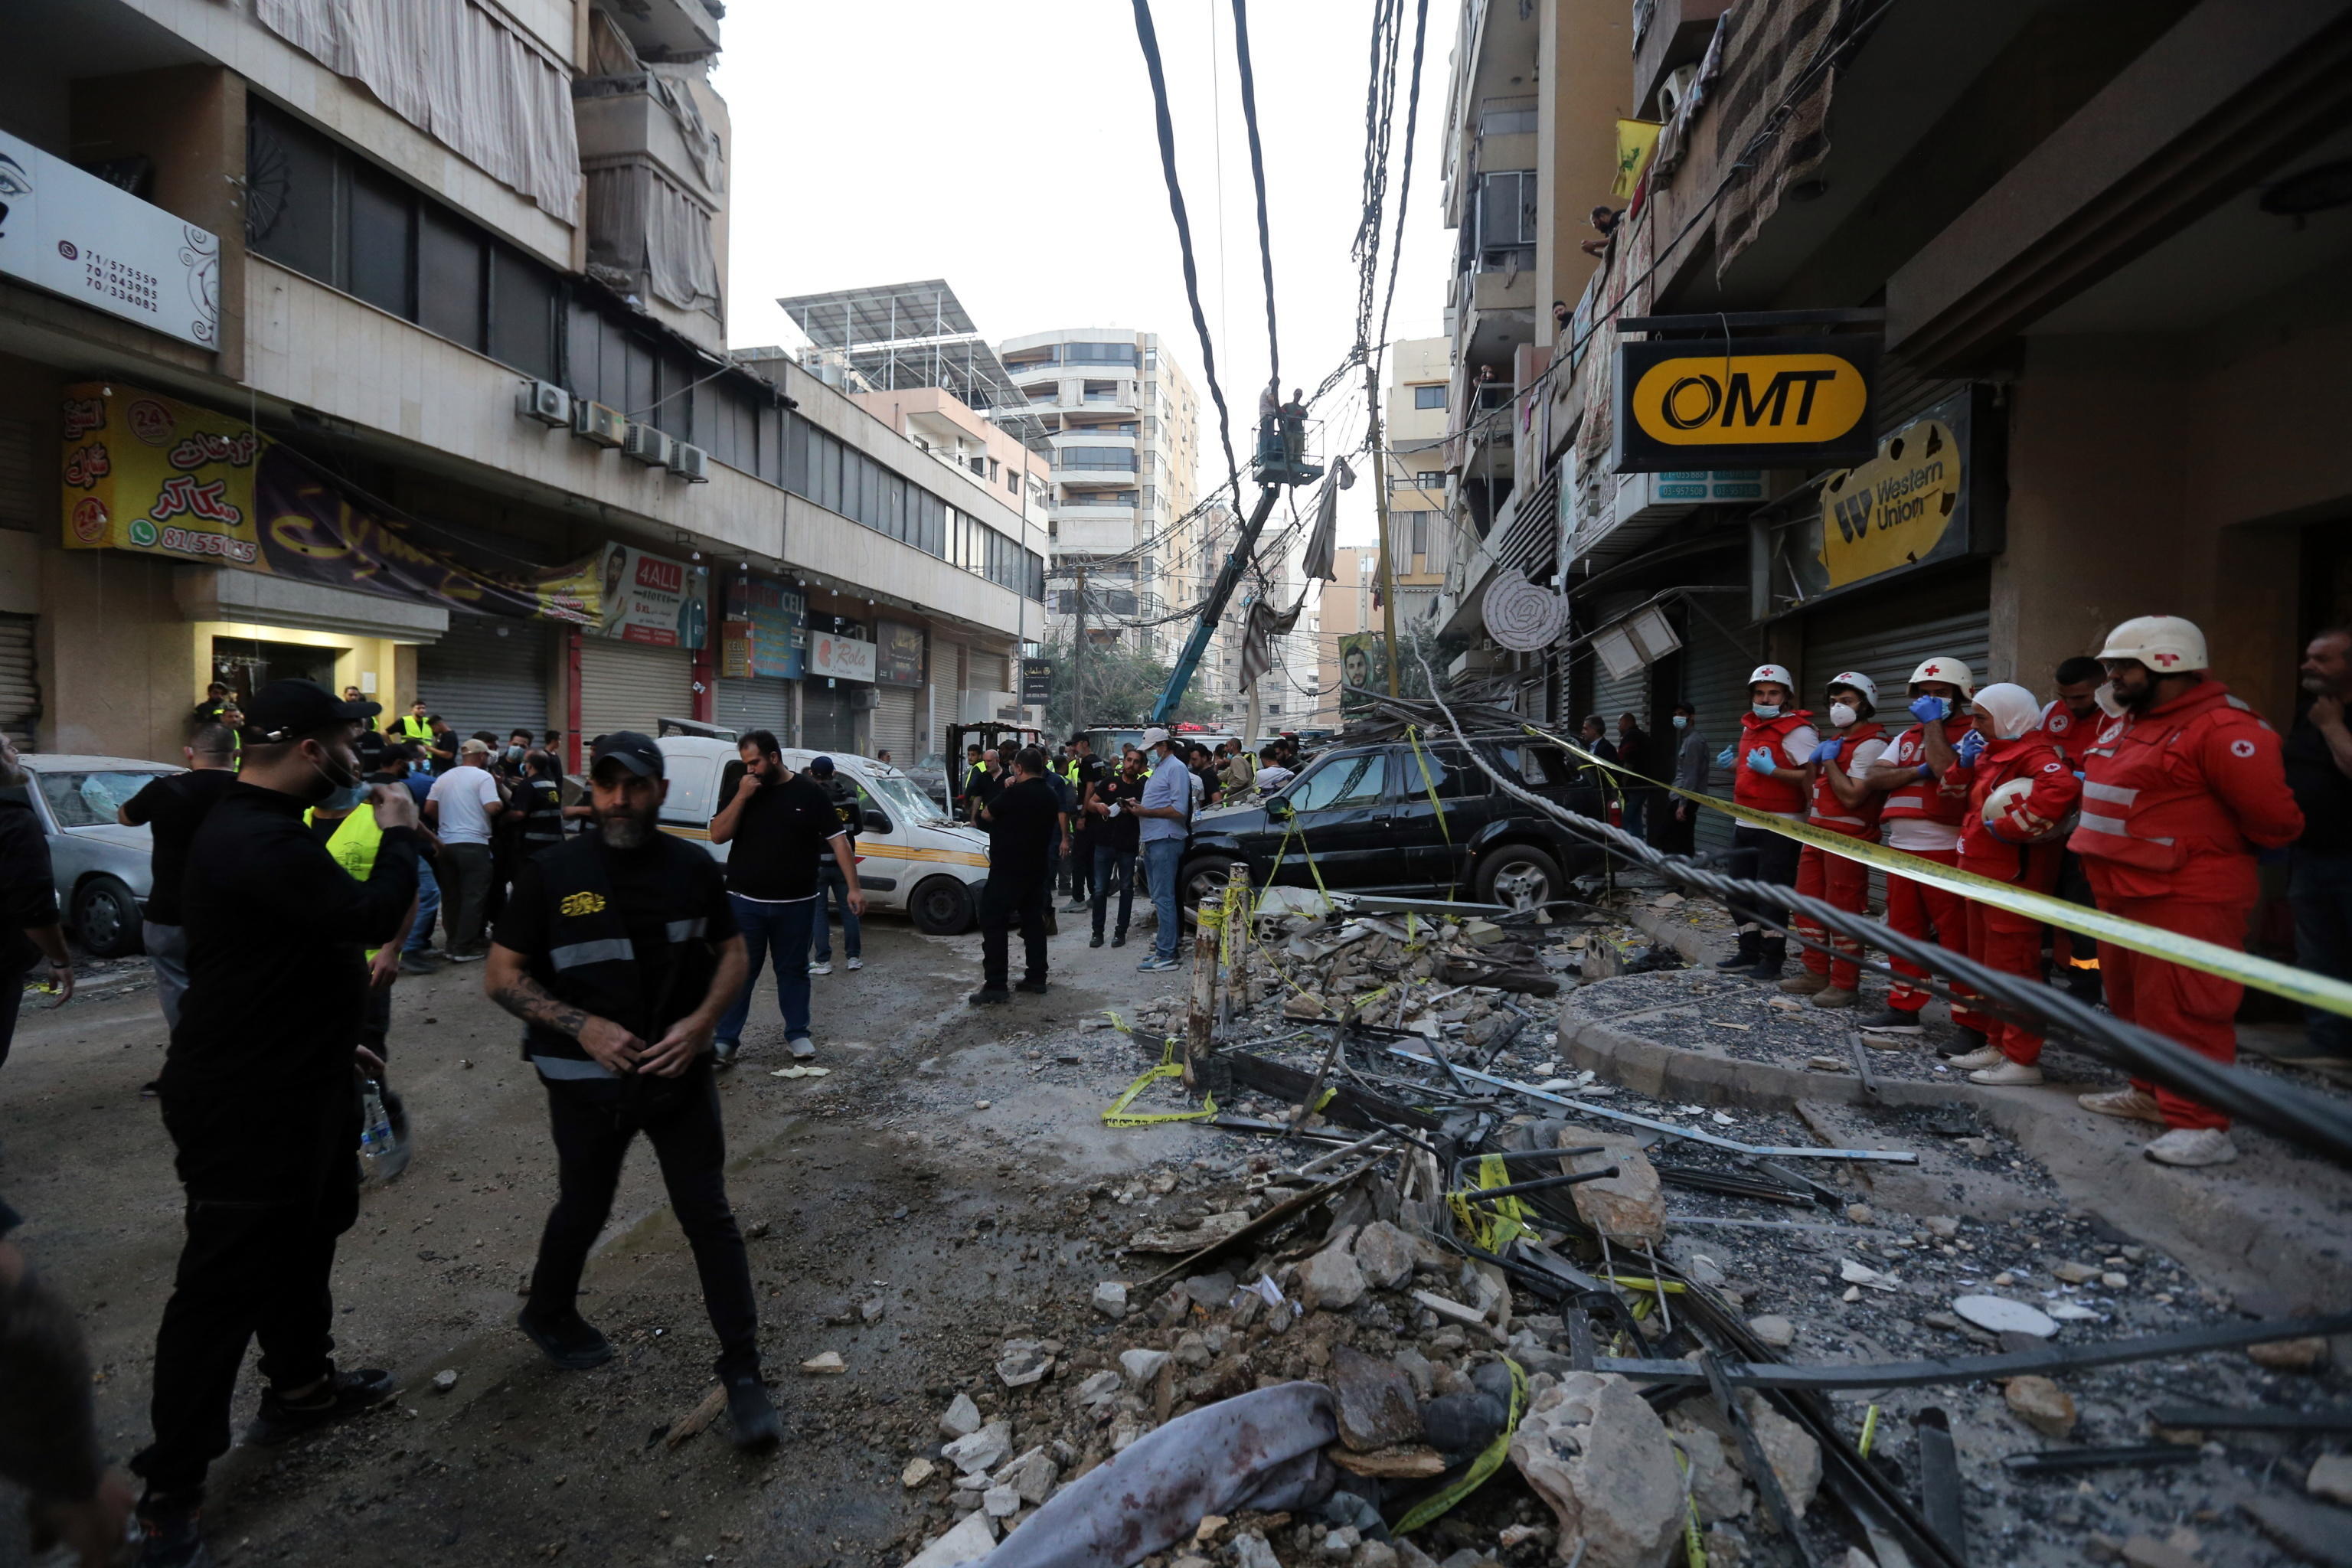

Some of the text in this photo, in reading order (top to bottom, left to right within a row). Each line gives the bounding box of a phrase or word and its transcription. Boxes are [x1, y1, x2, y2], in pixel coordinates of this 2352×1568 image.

[86, 250, 158, 286] 71/575559
[86, 263, 158, 300] 70/043985
[86, 276, 158, 313] 70/336082
[1661, 370, 1837, 430] OMT
[153, 478, 240, 522] سكاكر
[1877, 461, 1943, 505] Western
[1877, 496, 1924, 531] Union
[639, 563, 678, 590] 4ALL
